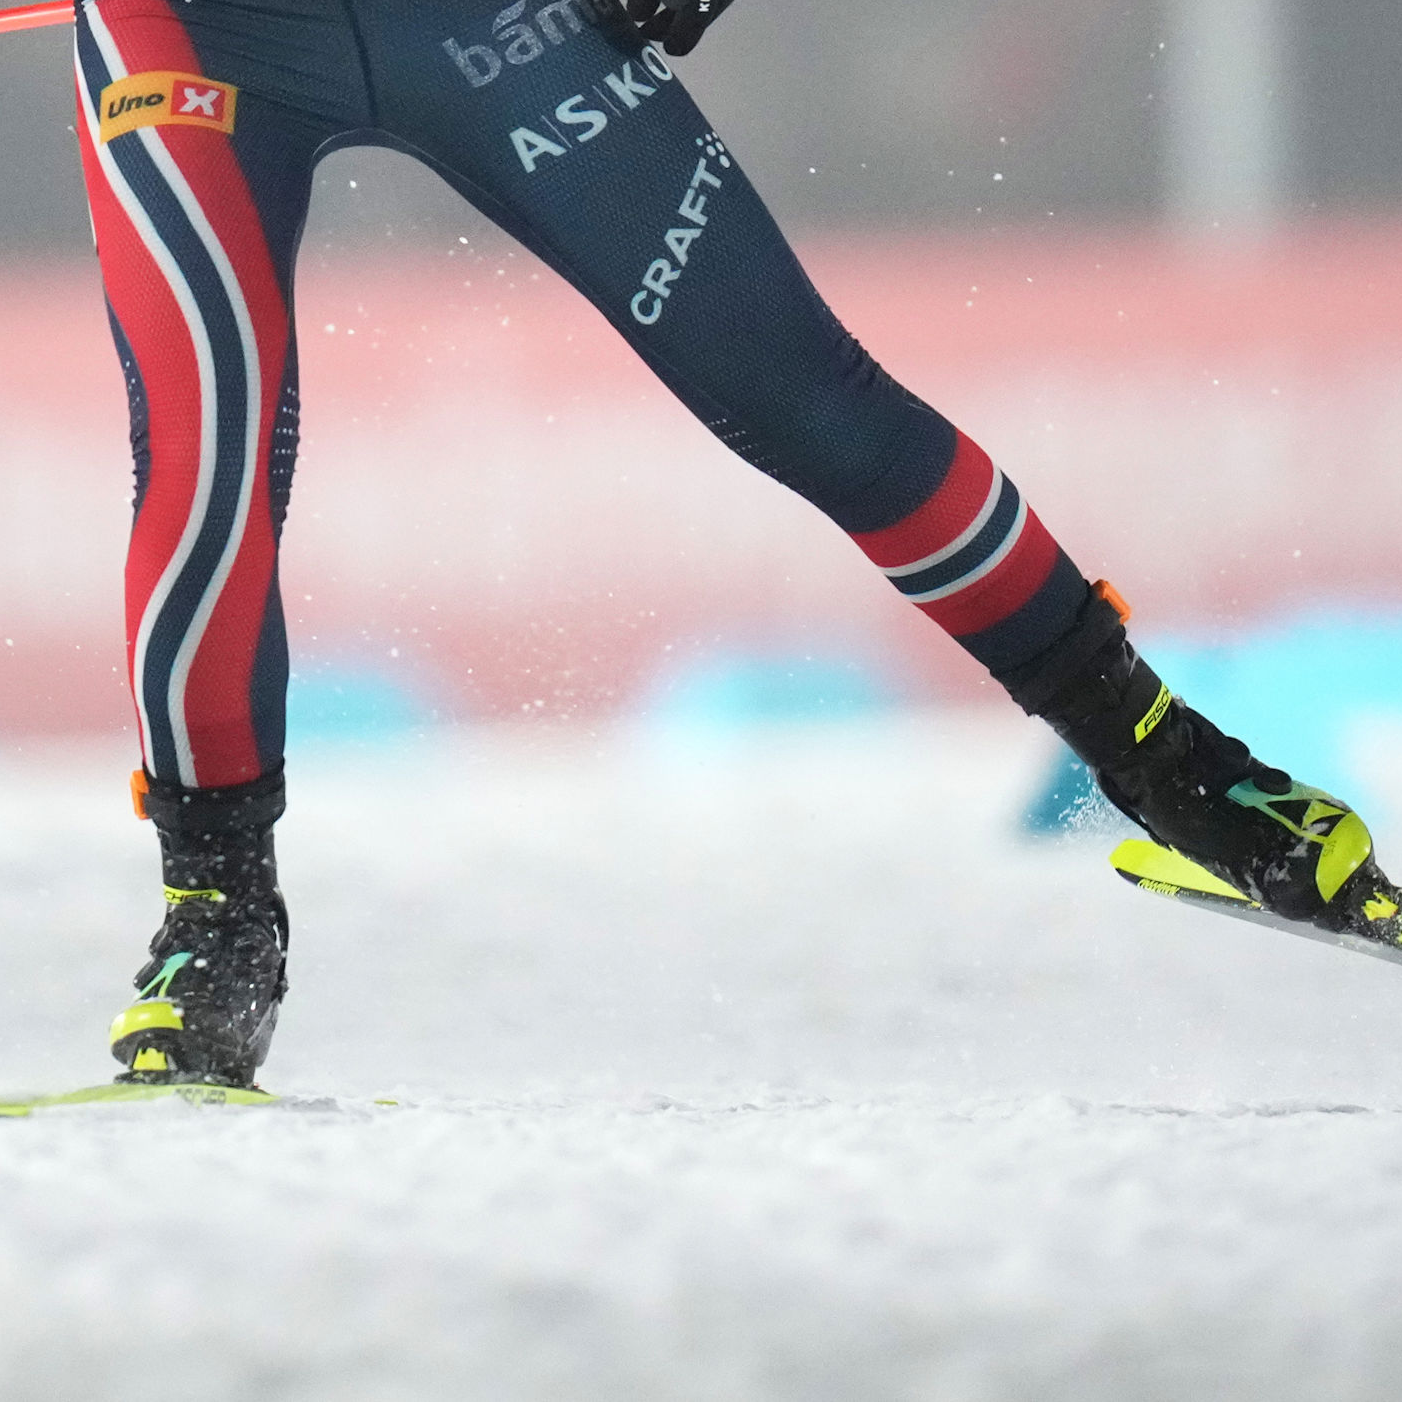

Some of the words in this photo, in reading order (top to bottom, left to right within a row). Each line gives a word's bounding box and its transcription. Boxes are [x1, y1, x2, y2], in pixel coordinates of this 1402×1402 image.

[108, 93, 166, 120] Uno
[179, 87, 221, 116] X
[630, 157, 723, 326] CRAFT
